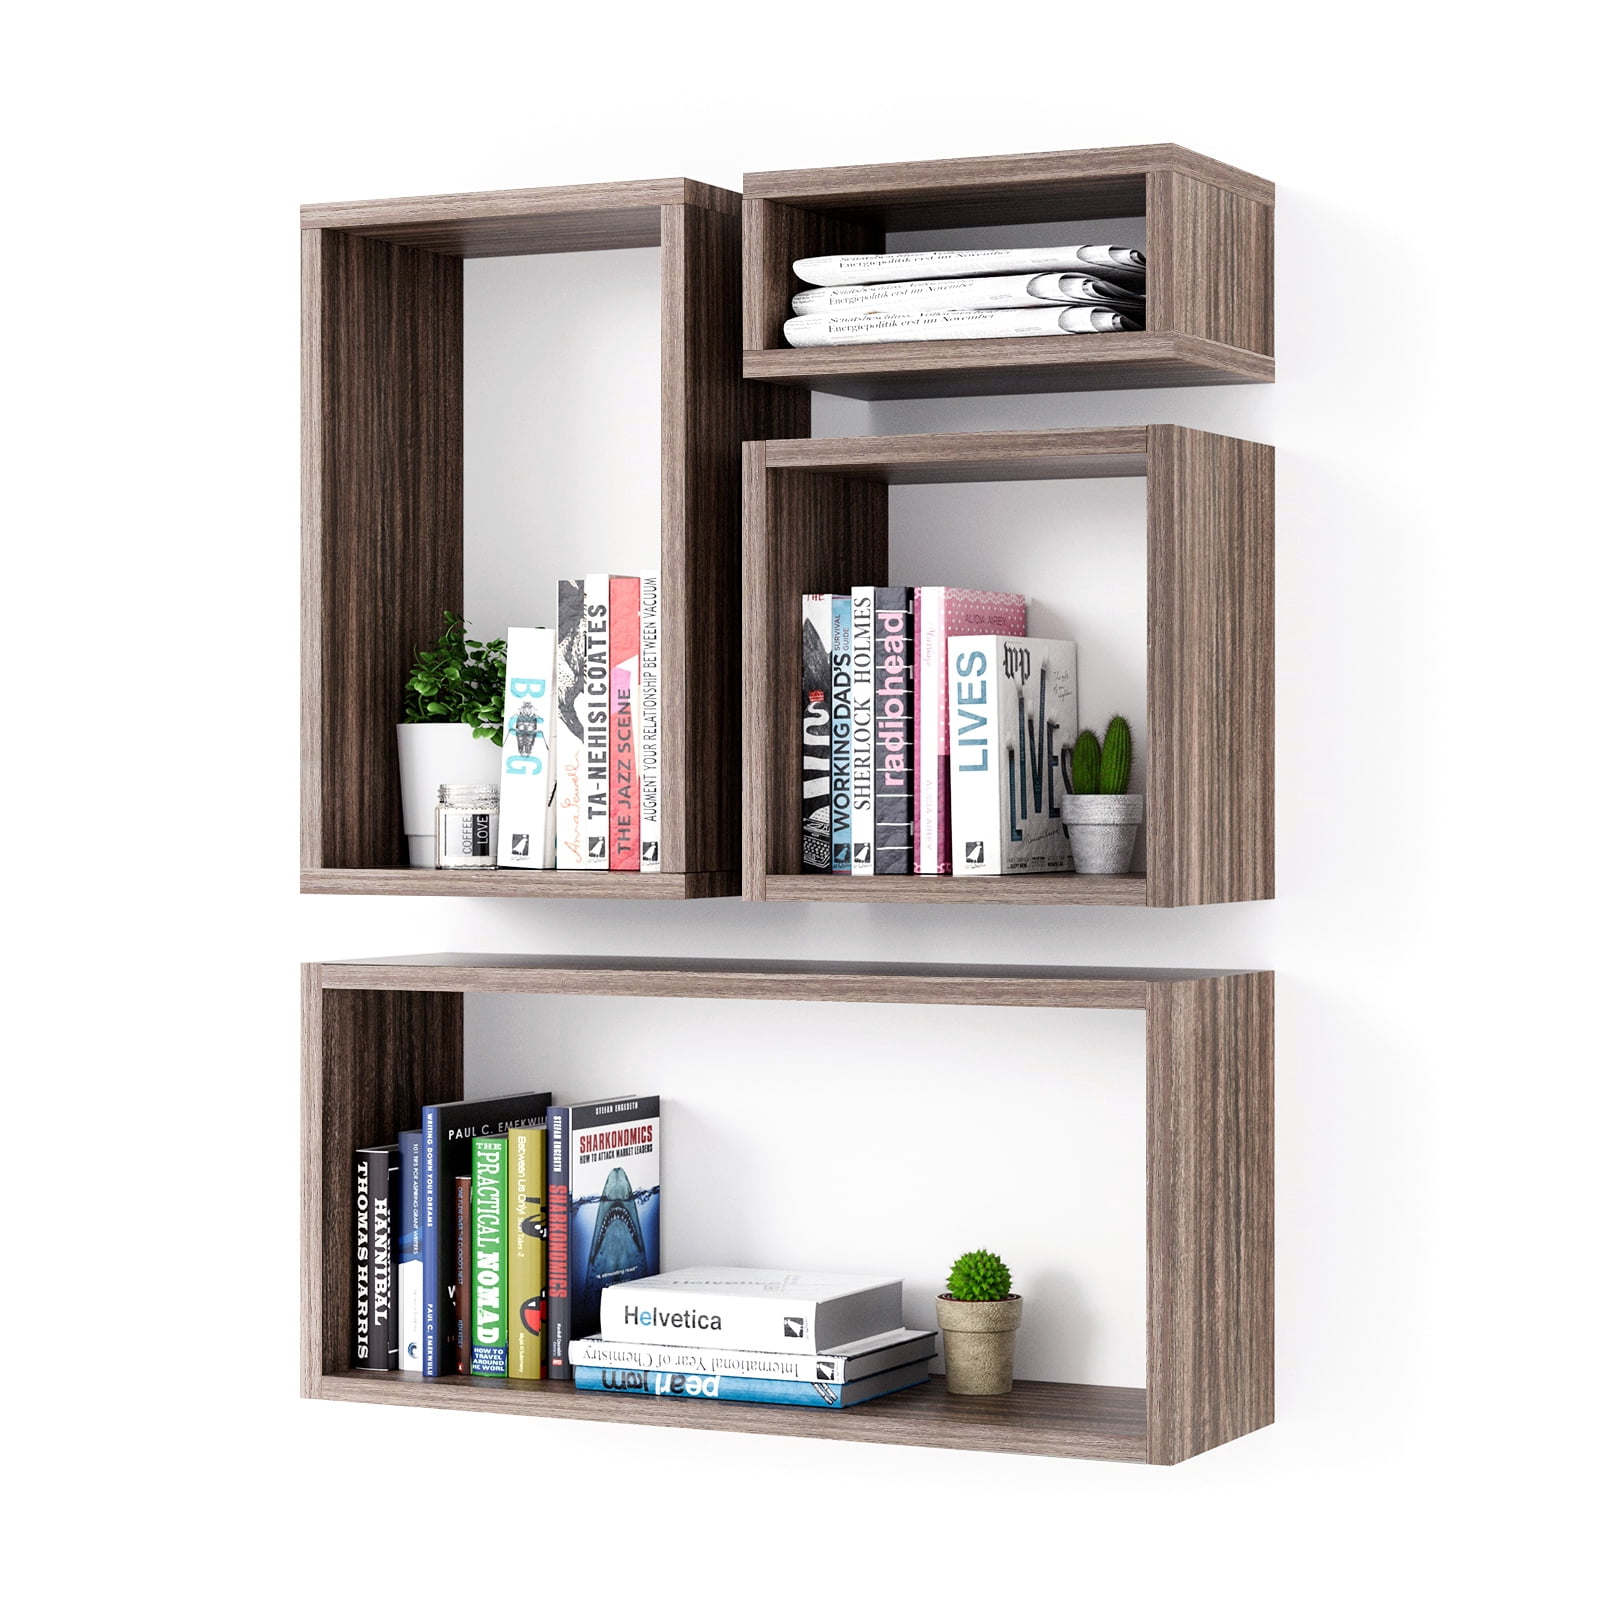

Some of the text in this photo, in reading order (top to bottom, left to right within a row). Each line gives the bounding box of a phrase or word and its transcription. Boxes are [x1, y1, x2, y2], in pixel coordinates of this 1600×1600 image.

[829, 289, 889, 305] Energiepolitik
[828, 318, 899, 333] Energiepolitik
[900, 318, 920, 327] erst
[923, 317, 938, 325] im
[943, 313, 995, 322] November
[588, 604, 607, 821] TA-NEHISI COATES
[643, 577, 657, 823] AUGMENT YOUR RELATIONSHIP BETWEEN VACUUM
[853, 597, 871, 810] SHERLOCK HOLMES
[878, 612, 905, 787] radiohead
[955, 651, 989, 772] LIVES
[833, 653, 852, 834] WORKING DAD'S
[617, 688, 632, 854] THE JAZZ SCENE
[462, 816, 473, 855] COFFEE
[476, 814, 489, 845] LOVE
[595, 1104, 613, 1115] STEFAN
[448, 1115, 547, 1141] PAUL C. EMEKWU
[553, 1115, 562, 1139] STEFAN
[580, 1124, 653, 1154] SHARKONOMICS
[476, 1142, 502, 1151] THE
[517, 1135, 527, 1178] Between
[579, 1143, 653, 1165] HOW TO ATTACK MARKET LEADERS
[517, 1180, 526, 1193] Us
[477, 1151, 500, 1344] PRACTICAL NOMAD
[548, 1184, 568, 1298] SHARKONOMICS
[357, 1161, 369, 1359] THOMAS HARRIS
[374, 1197, 388, 1326] HANNIBAL
[427, 1324, 434, 1333] C.
[624, 1305, 722, 1330] Helvetica
[473, 1358, 504, 1366] AROUND
[475, 1352, 502, 1361] TRAVEL
[582, 1345, 799, 1378] International Year of Chemistry
[655, 1372, 721, 1398] pearl
